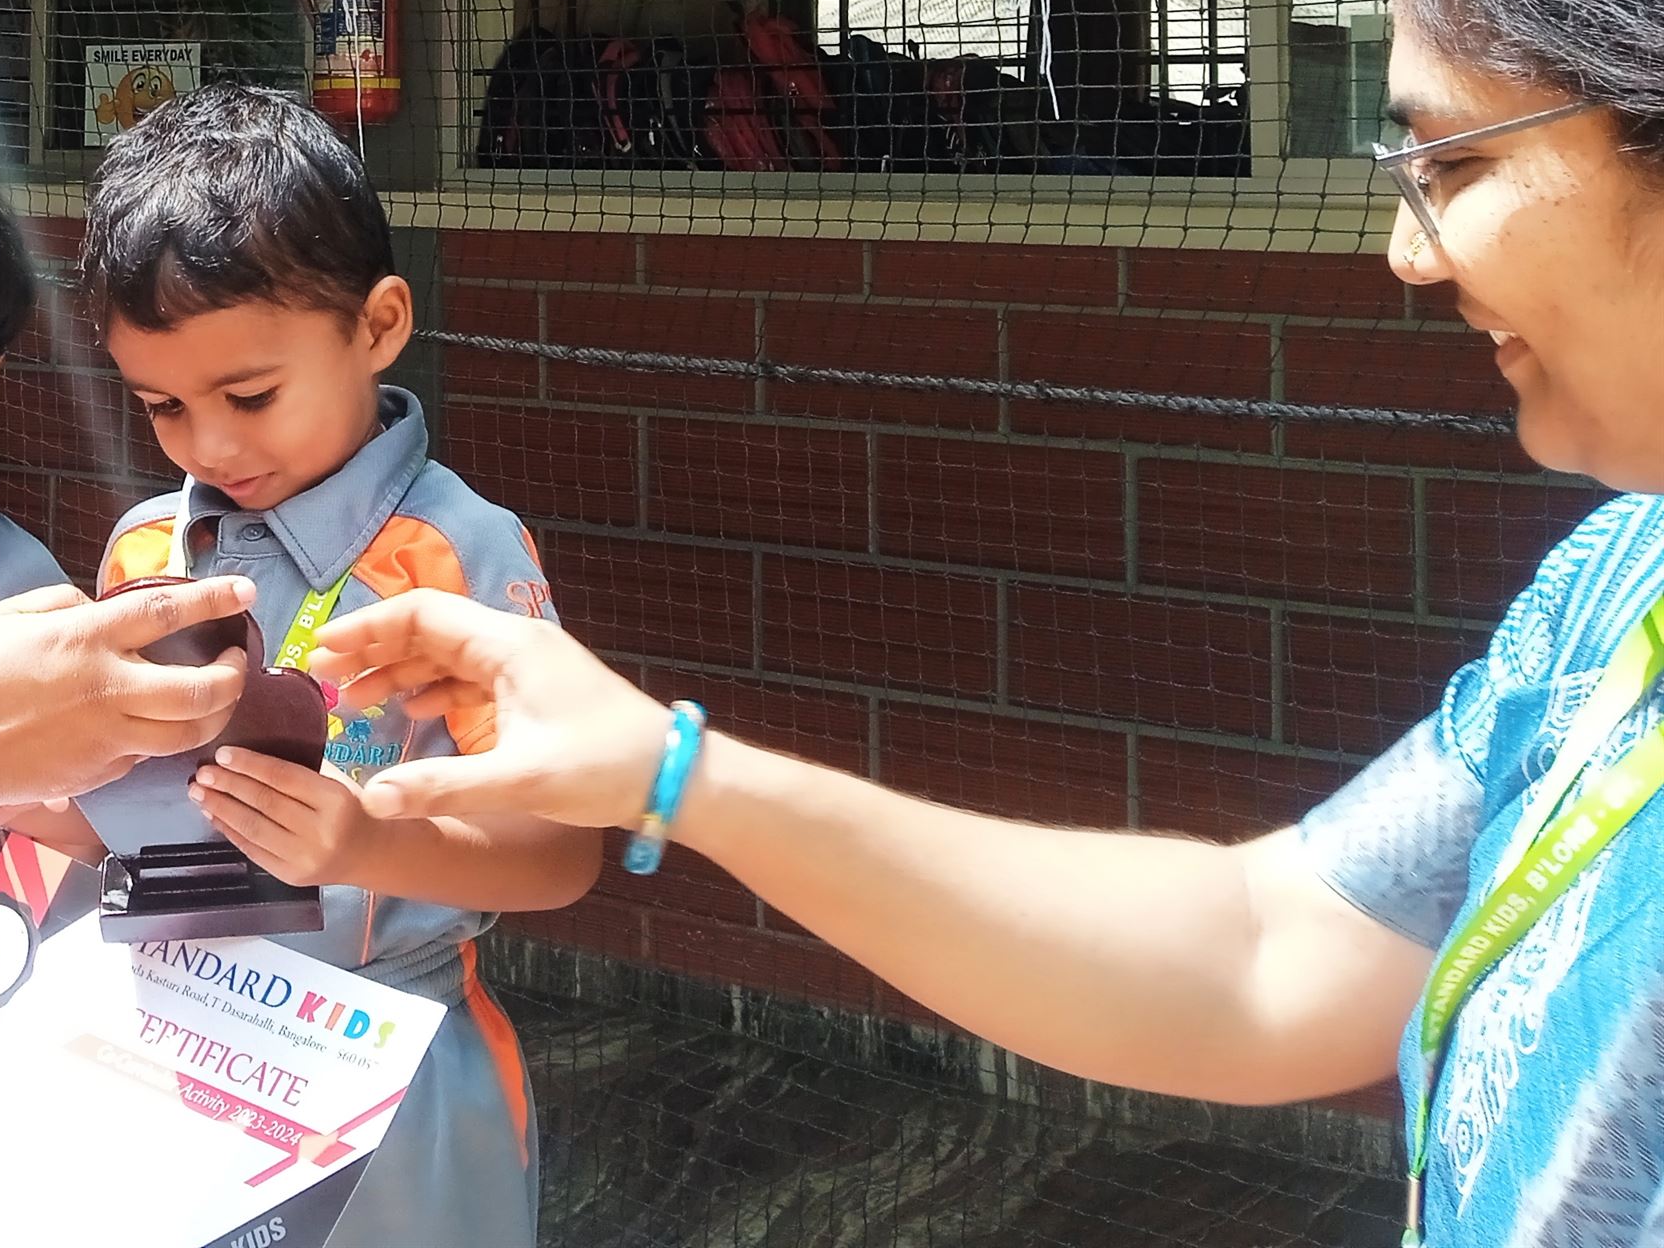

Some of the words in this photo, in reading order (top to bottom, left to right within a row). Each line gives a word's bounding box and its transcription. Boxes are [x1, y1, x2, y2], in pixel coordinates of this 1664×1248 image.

[93, 50, 128, 63] SMILE
[132, 48, 193, 62] EVERYDAY
[1483, 892, 1537, 938] KIDS,
[295, 991, 396, 1049] KIDS
[181, 1082, 230, 1121] Activity
